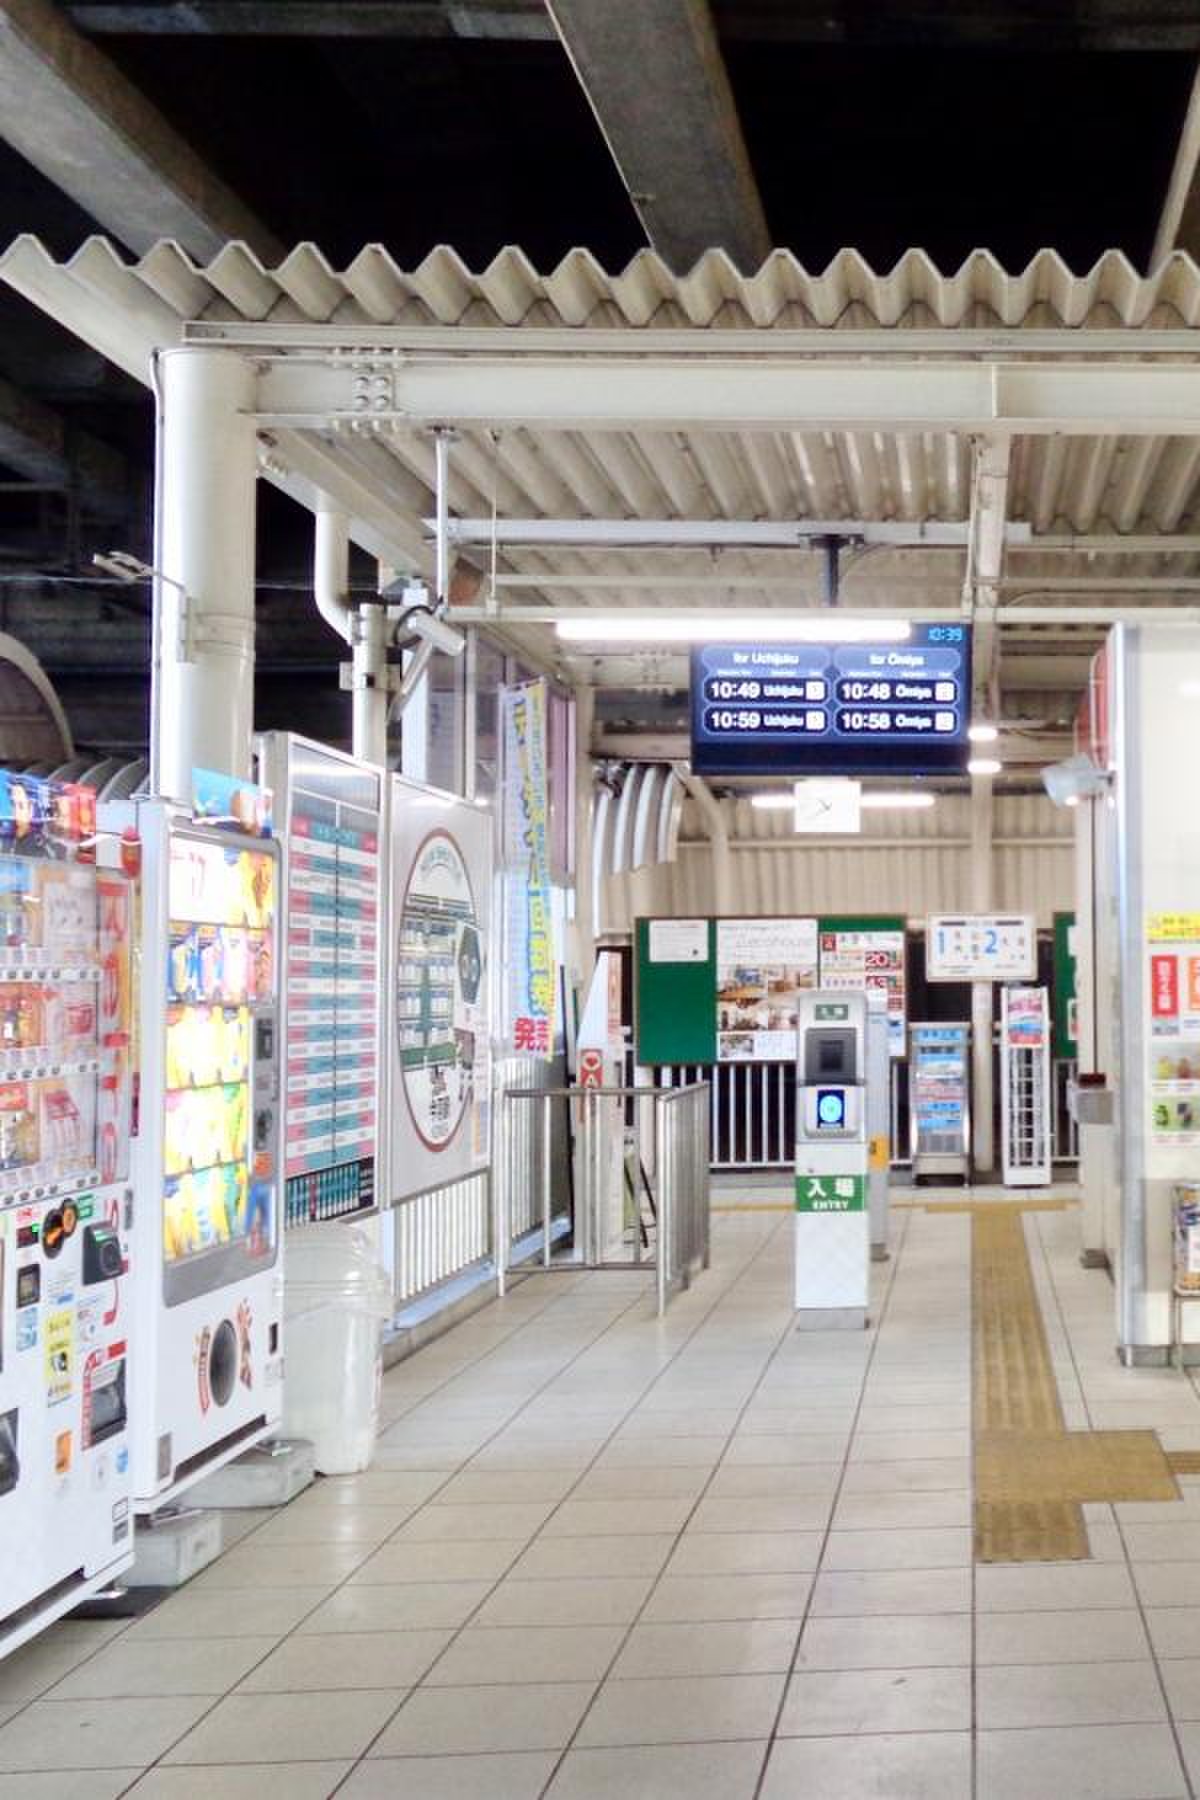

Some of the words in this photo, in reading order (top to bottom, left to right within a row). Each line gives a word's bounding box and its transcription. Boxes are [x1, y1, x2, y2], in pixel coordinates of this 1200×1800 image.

[711, 682, 760, 698] 10:49
[711, 712, 760, 728] 10:59
[984, 929, 998, 953] 2
[807, 1179, 855, 1198] 入場
